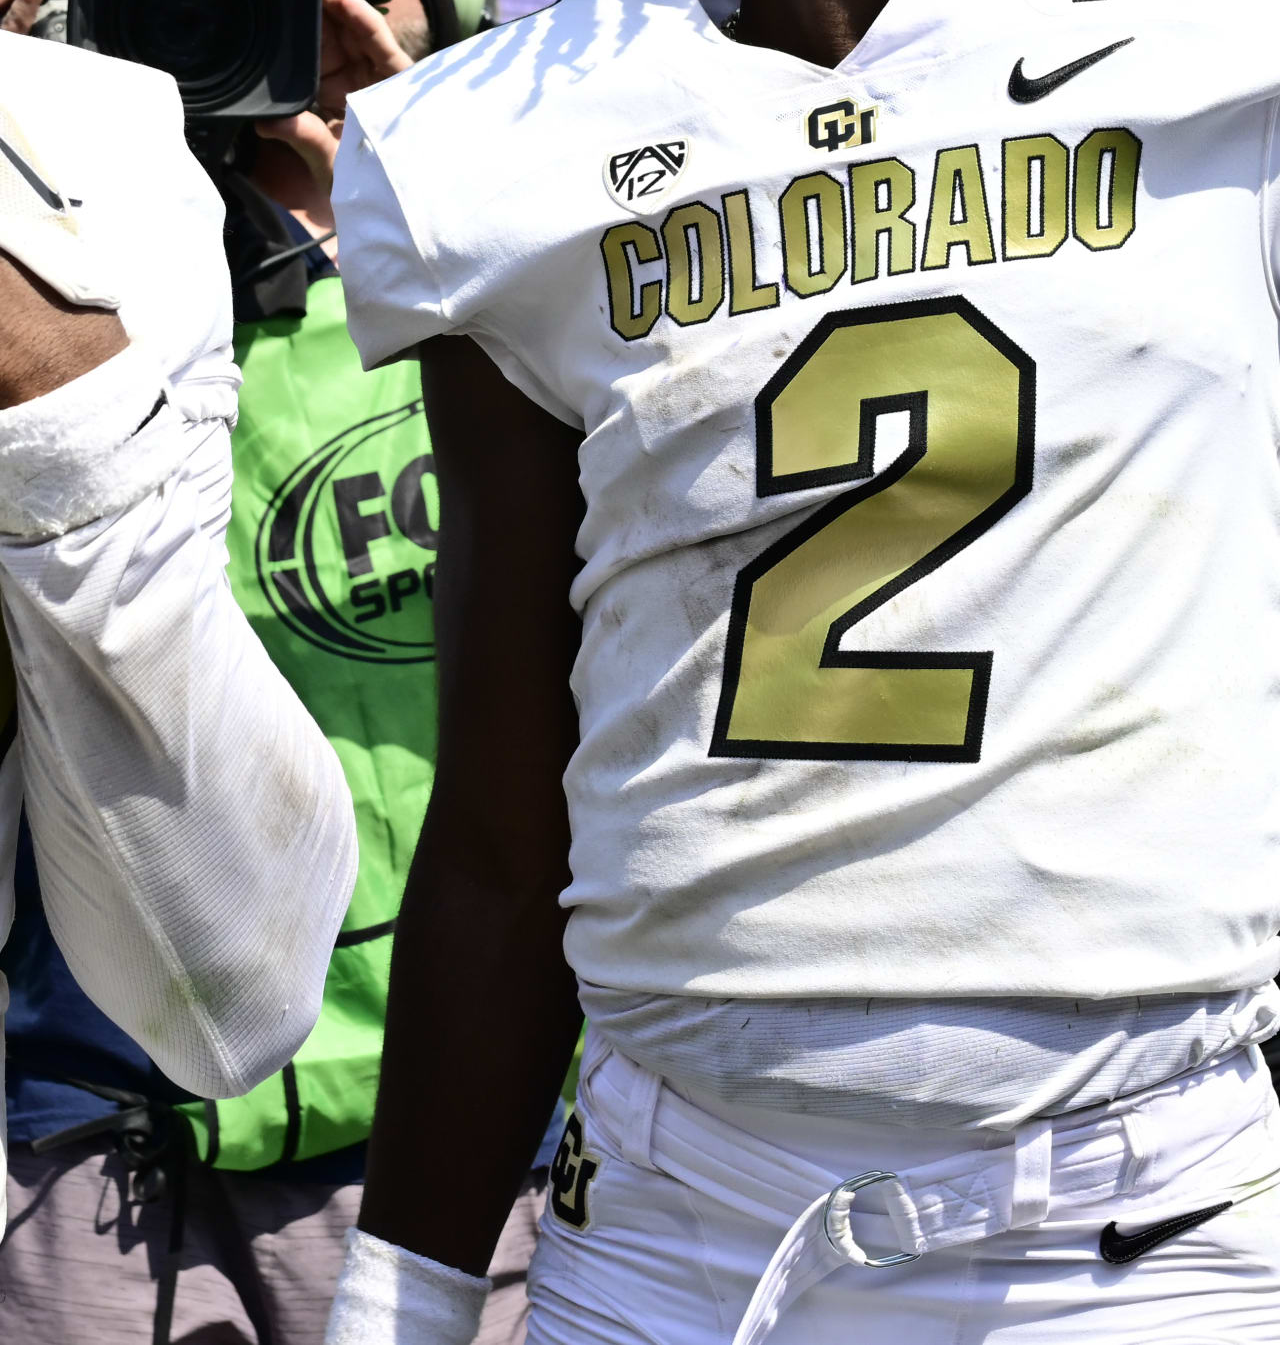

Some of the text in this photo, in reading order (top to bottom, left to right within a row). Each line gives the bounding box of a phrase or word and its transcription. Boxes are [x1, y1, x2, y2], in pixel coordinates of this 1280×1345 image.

[609, 140, 686, 193] PAC
[627, 169, 667, 201] 12
[600, 127, 1144, 342] COLORADO
[332, 453, 440, 579] FO
[708, 295, 1037, 763] 2
